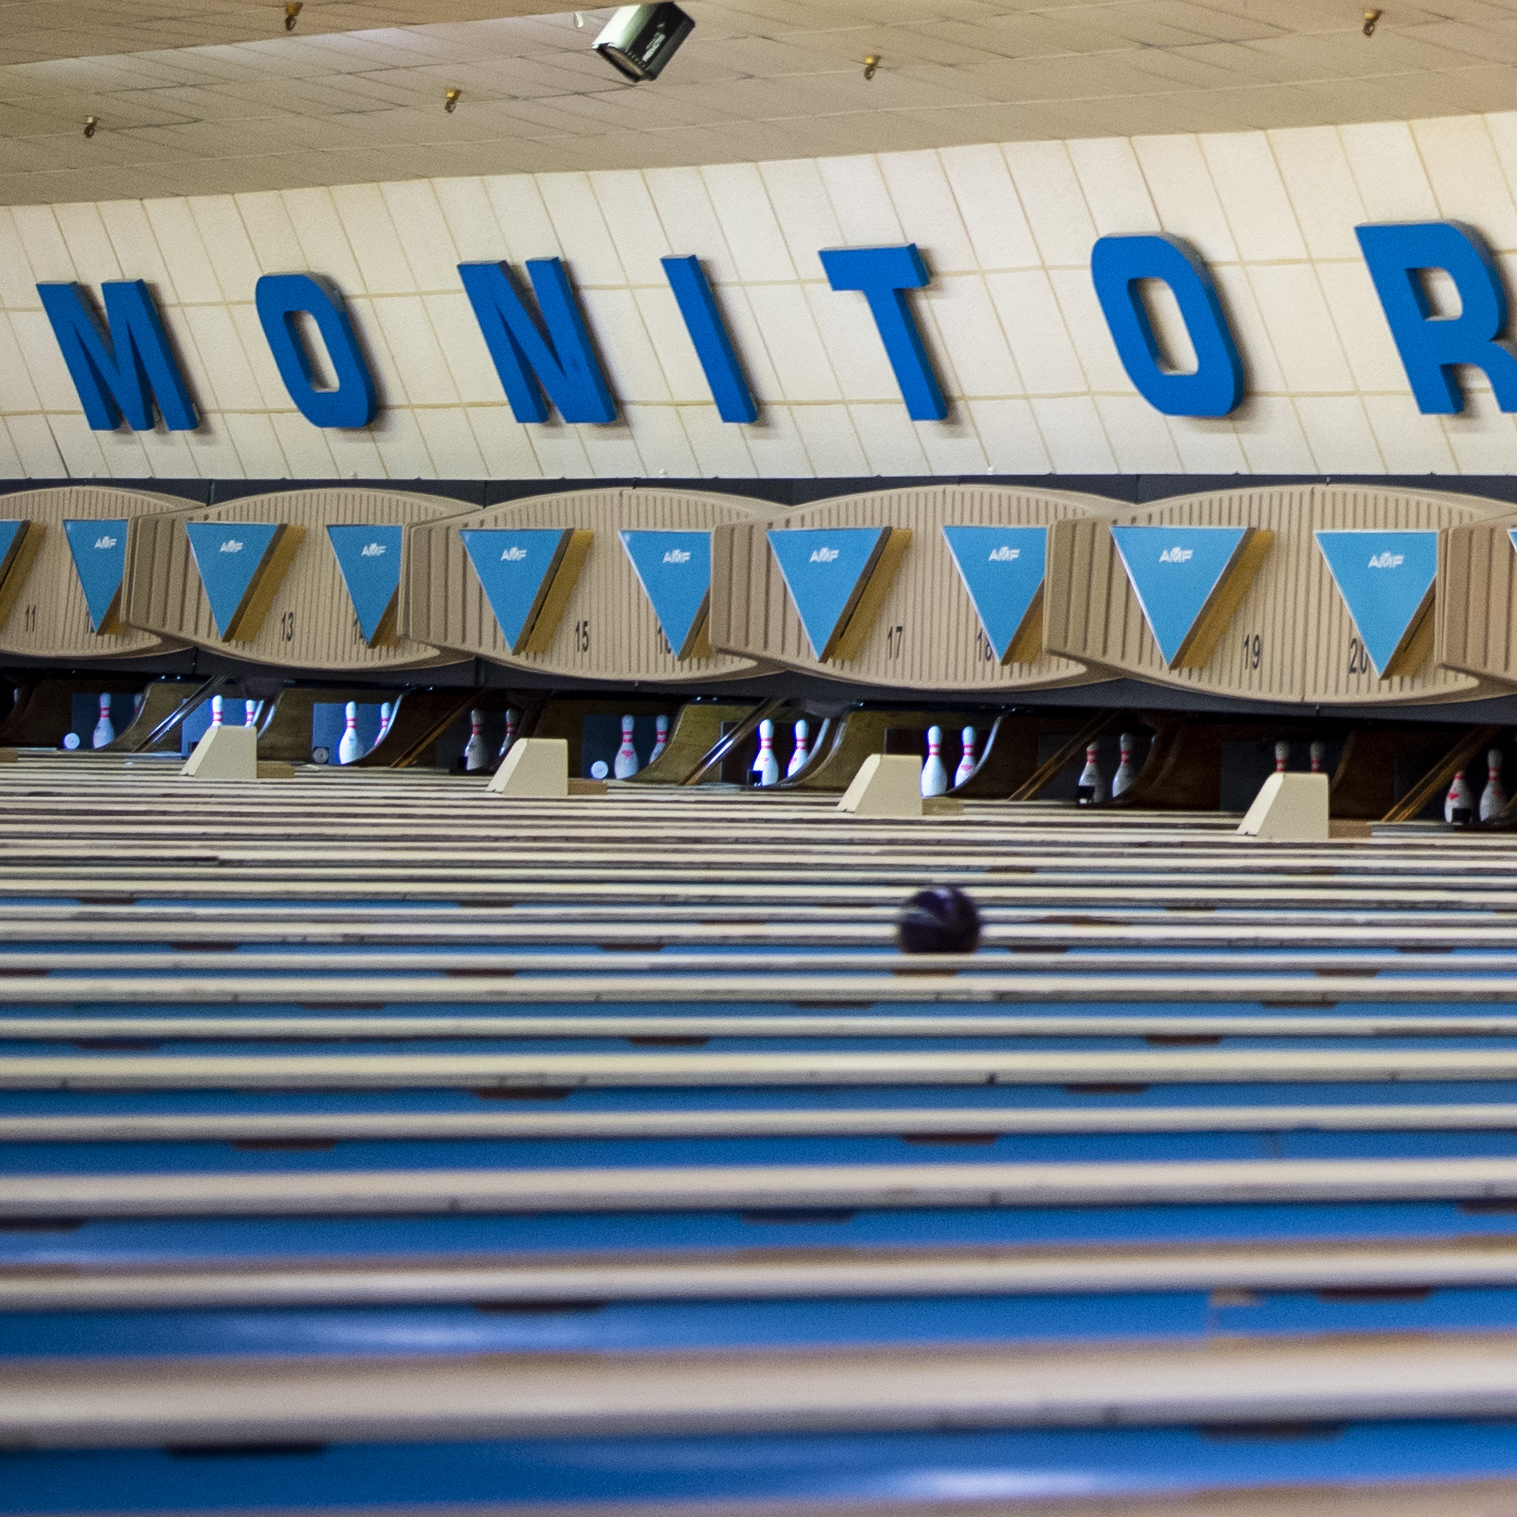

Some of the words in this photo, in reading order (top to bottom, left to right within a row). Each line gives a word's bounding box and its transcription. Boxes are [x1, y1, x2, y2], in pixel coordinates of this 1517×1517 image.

[662, 549, 691, 563] AMF
[809, 547, 840, 562] AMF
[988, 546, 1021, 561] AMF
[1159, 546, 1194, 563] AMF
[1368, 551, 1405, 569] AMF
[25, 604, 37, 633] 11
[281, 612, 293, 642] 13
[574, 620, 590, 651] 15
[886, 626, 902, 658] 17
[1244, 635, 1261, 669] 19
[1348, 638, 1368, 674] 20
